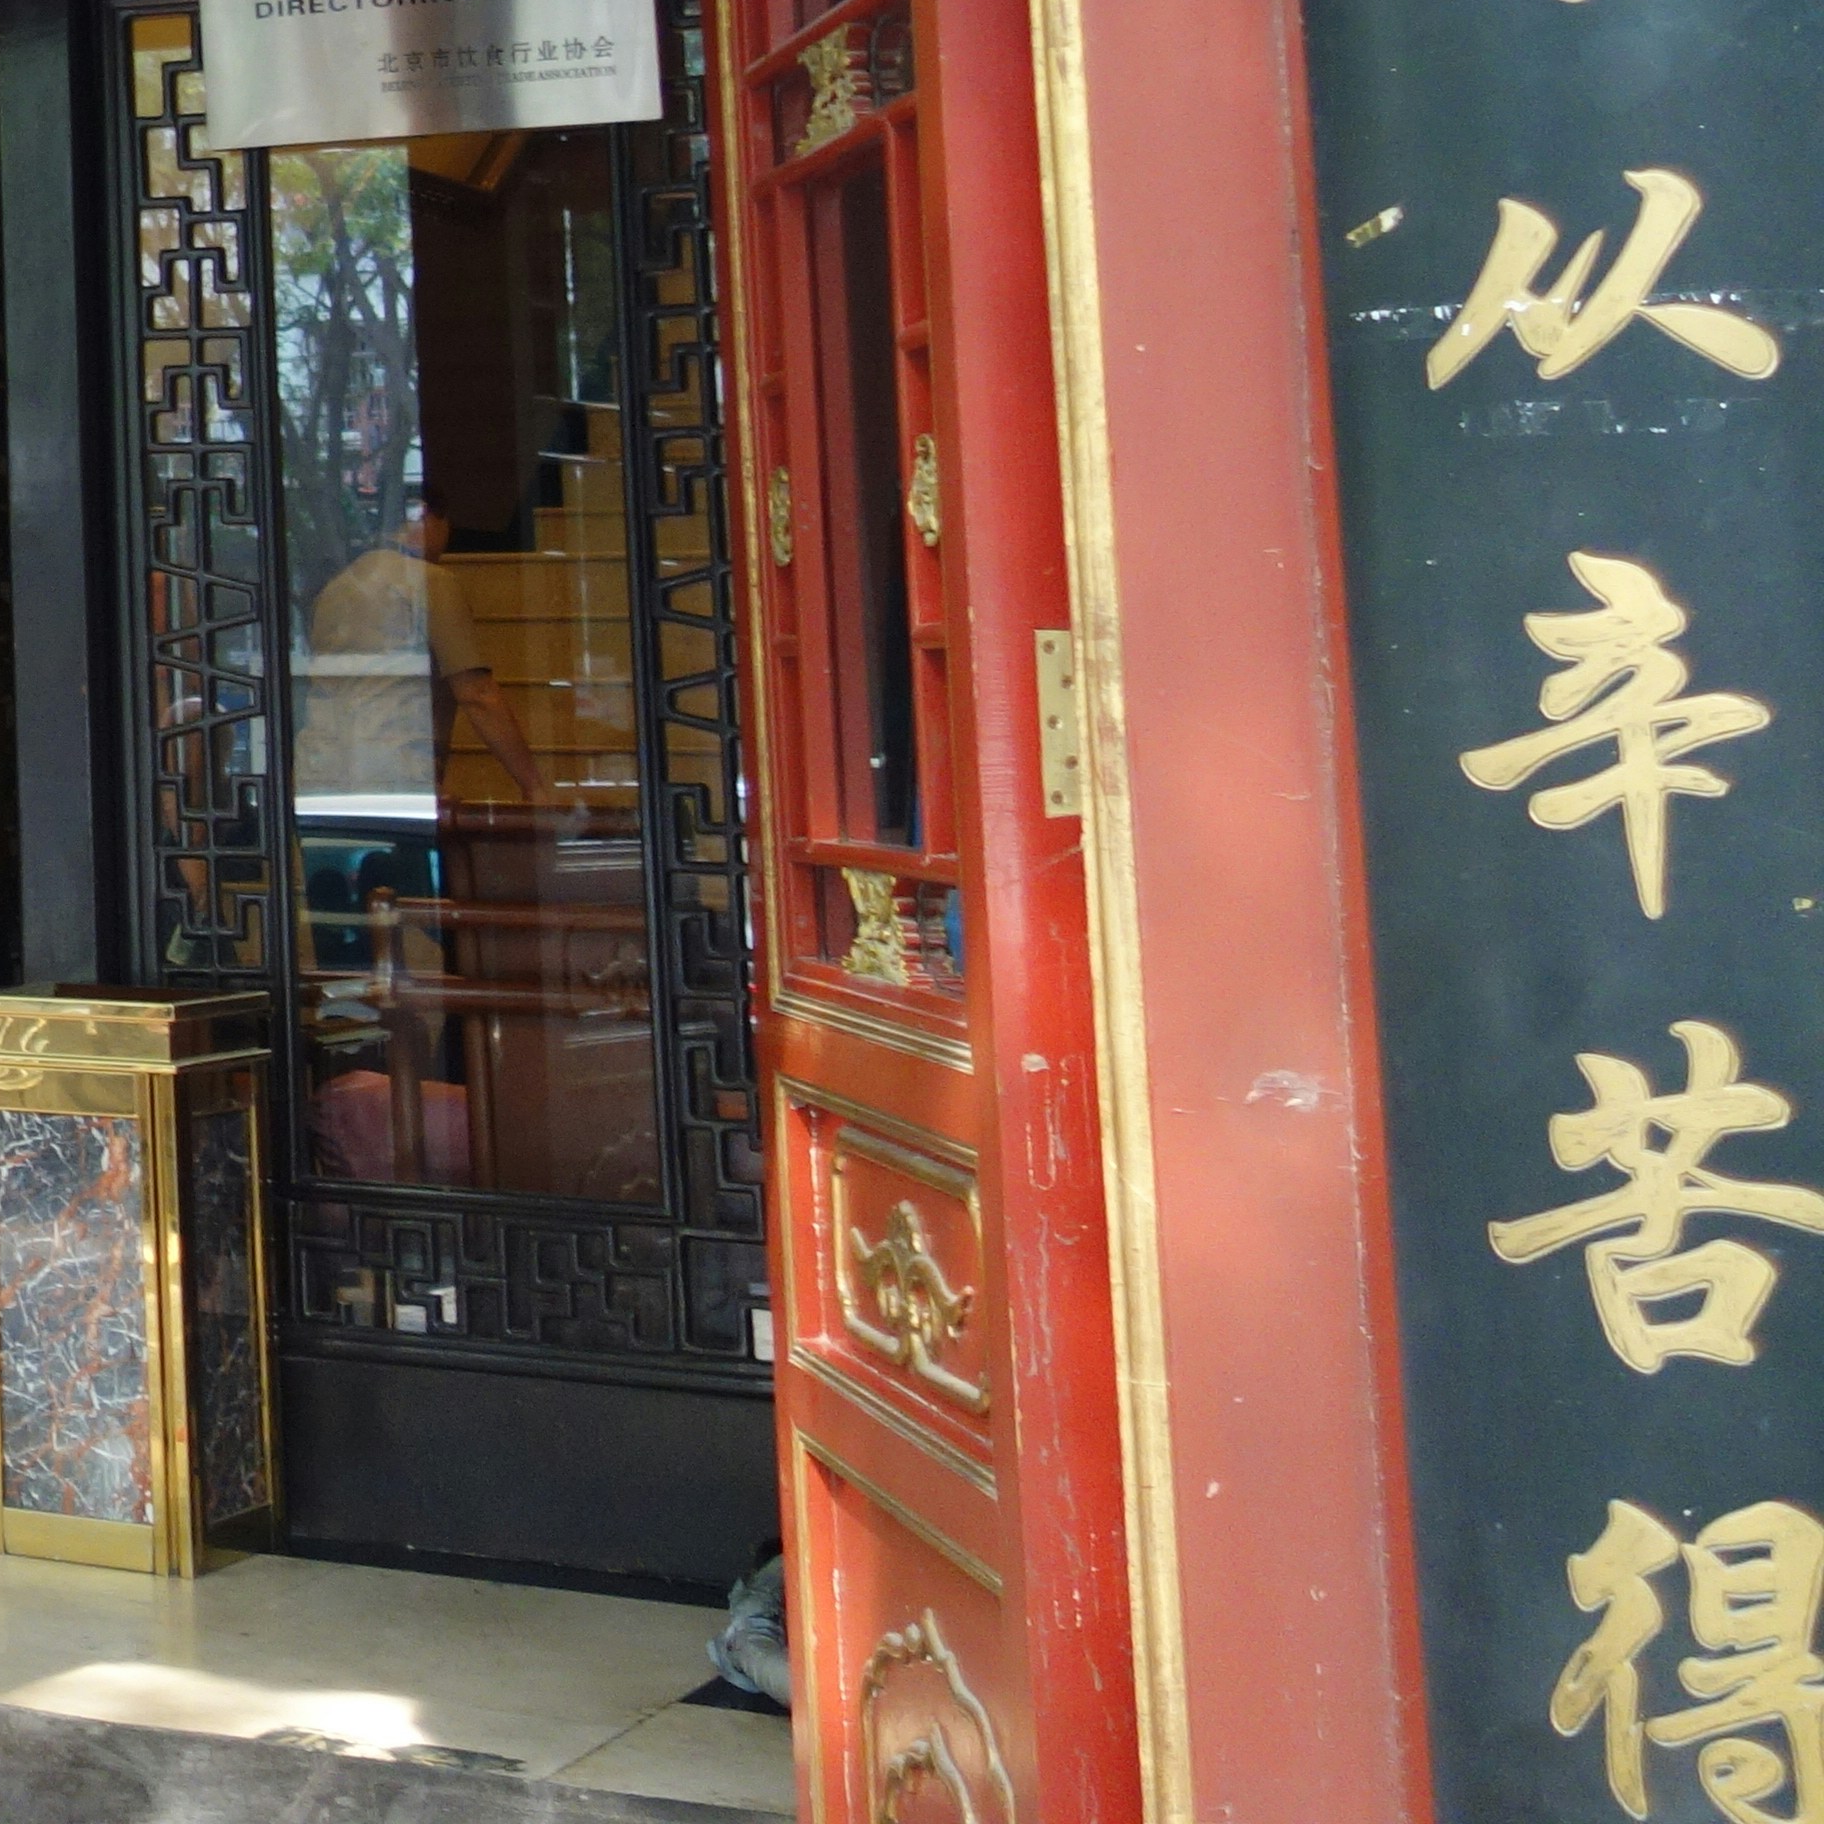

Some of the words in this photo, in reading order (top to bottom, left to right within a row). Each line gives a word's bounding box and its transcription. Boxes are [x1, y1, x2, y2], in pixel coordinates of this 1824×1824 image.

[377, 34, 616, 74] 北京市饮食行业协会
